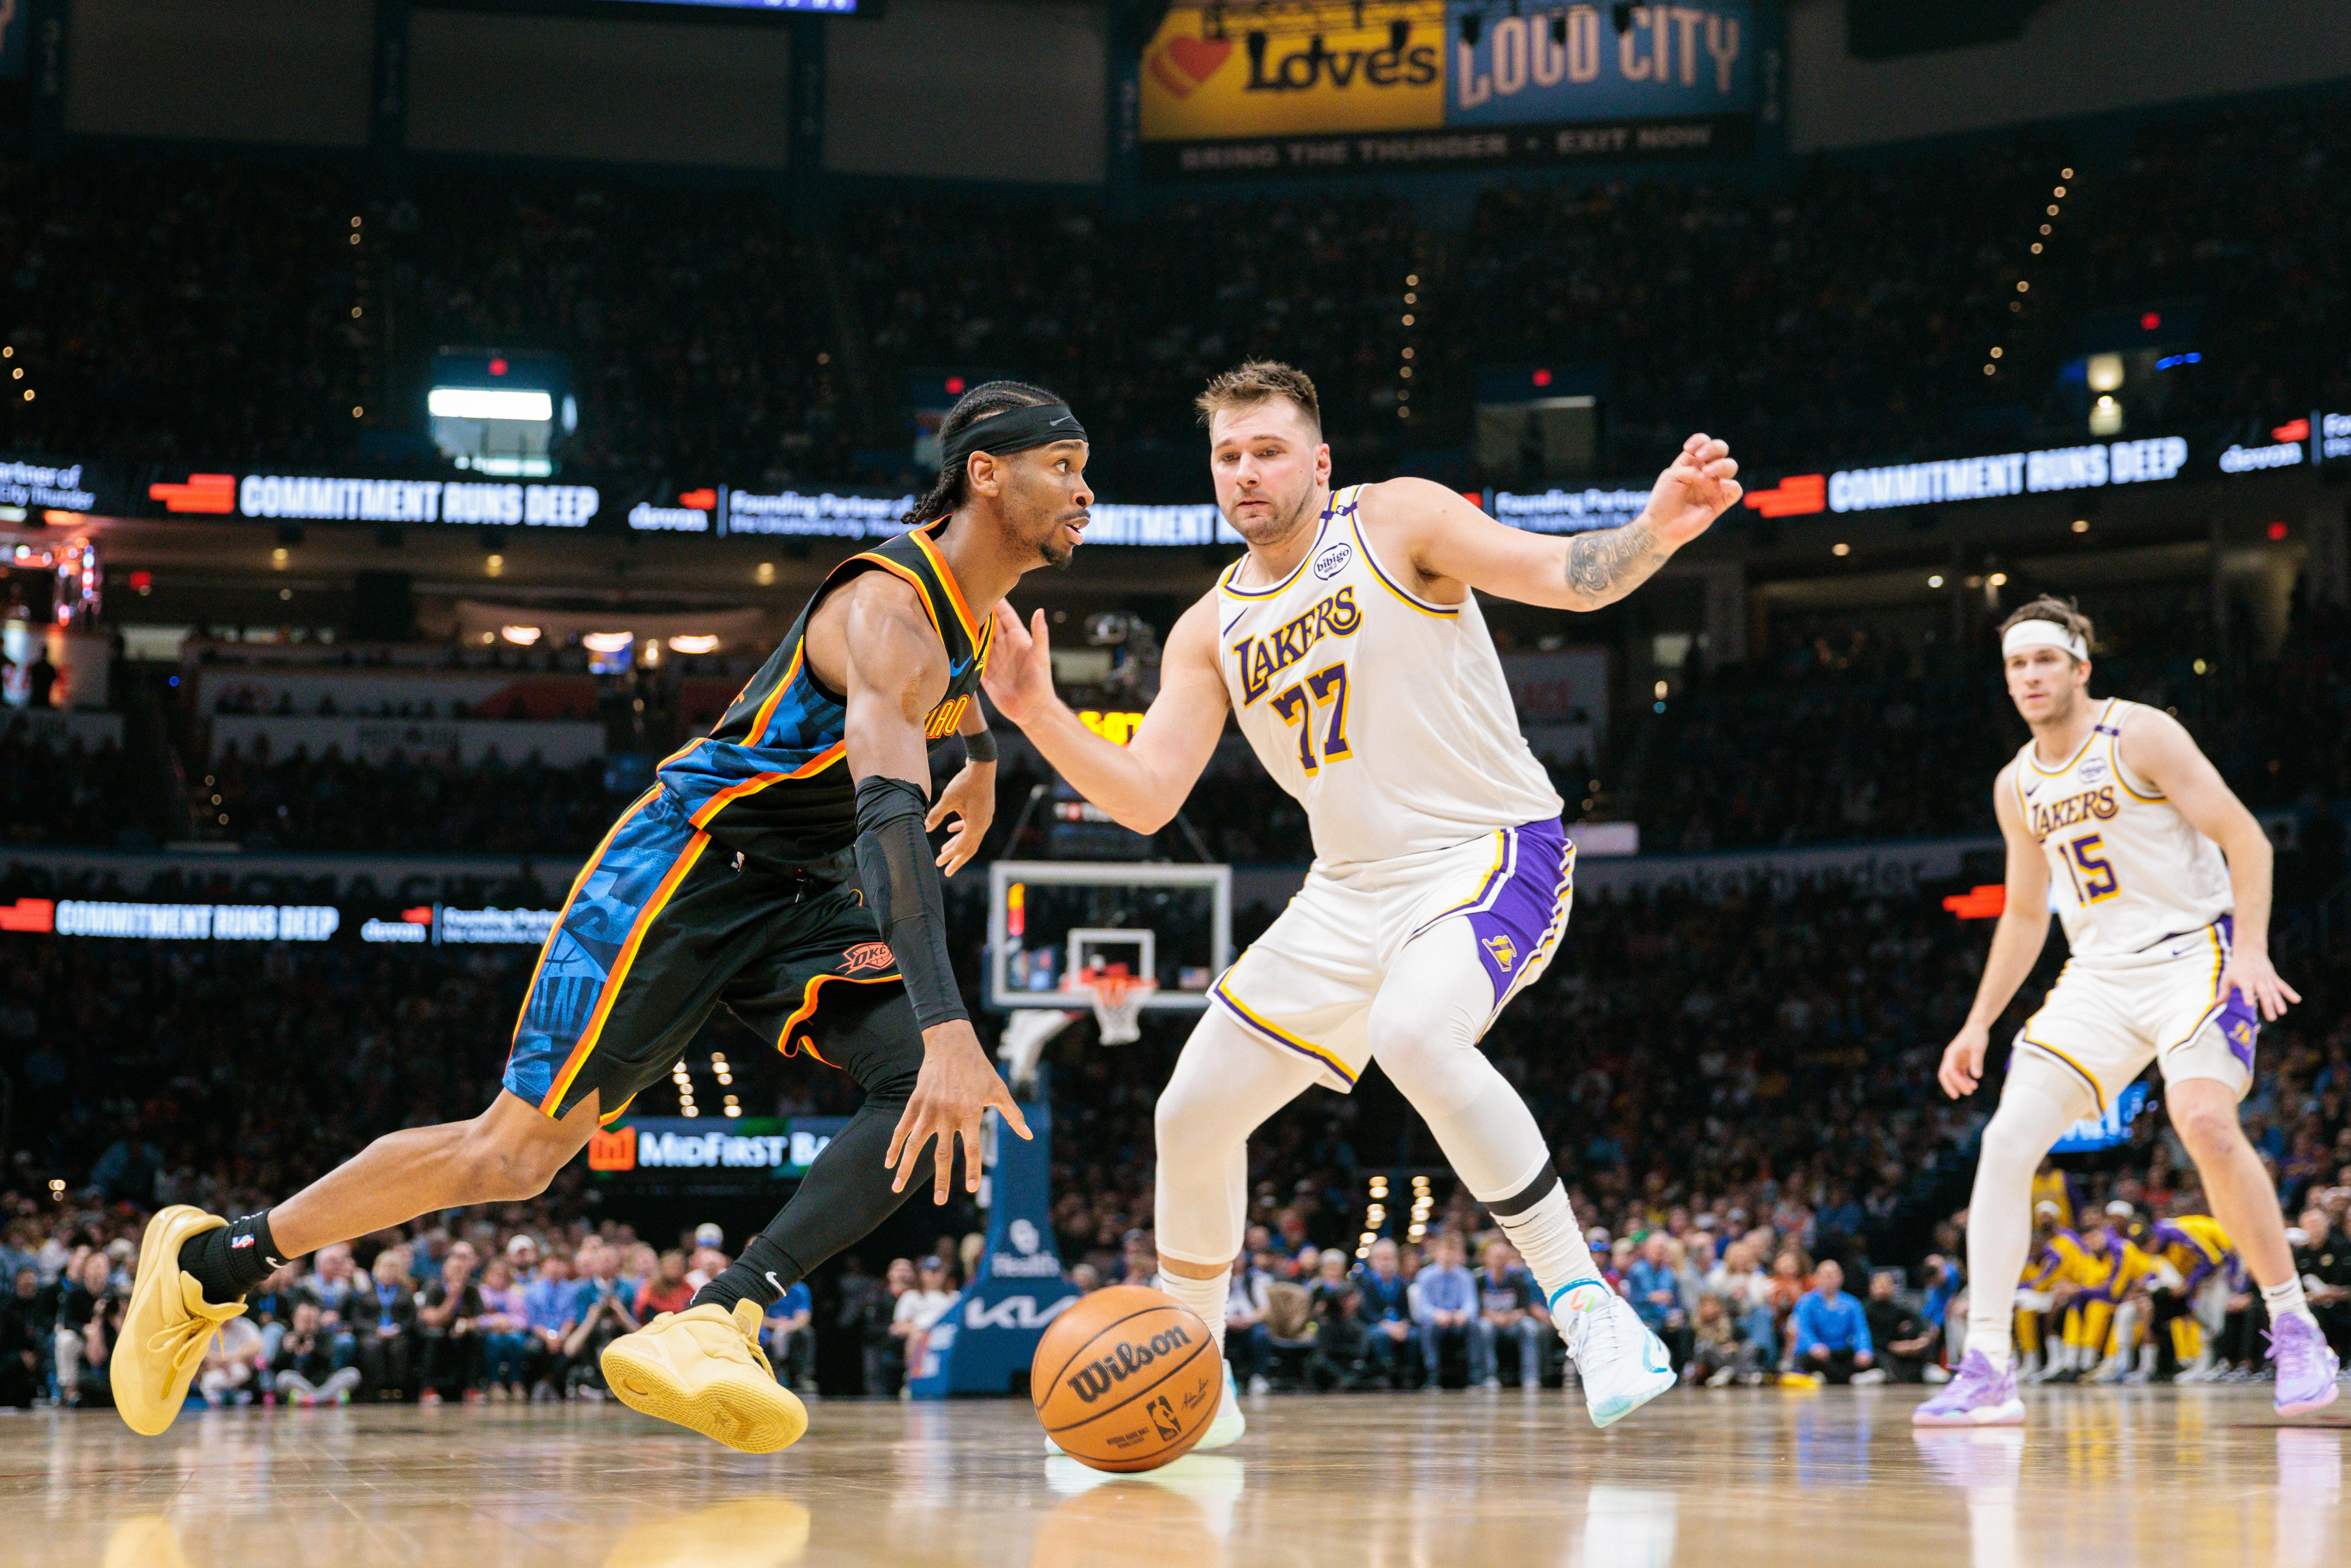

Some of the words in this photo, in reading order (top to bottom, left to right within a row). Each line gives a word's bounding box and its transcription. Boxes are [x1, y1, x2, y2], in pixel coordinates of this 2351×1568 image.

[1287, 141, 1346, 165] THE
[1357, 133, 1507, 162] THUNDER
[240, 474, 443, 523] COMMITMENT
[442, 481, 523, 525] RUNS
[524, 484, 599, 527] DEEP
[1828, 452, 2026, 513] COMMITMENT
[2026, 443, 2110, 493] RUNS
[2110, 435, 2188, 485] DEEP
[729, 490, 818, 520] Founding
[819, 493, 891, 519] Partner
[1317, 549, 1349, 572] bibigo
[1232, 585, 1364, 709] LAKERS
[1268, 660, 1354, 778] 77
[2032, 785, 2120, 849] LAKERS
[2058, 831, 2121, 908] 15
[56, 899, 213, 940] COMMITMENT
[212, 904, 278, 941] RUNS
[279, 904, 340, 941] DEEP
[853, 946, 887, 968] OKC
[1067, 1325, 1193, 1404] Wilson
